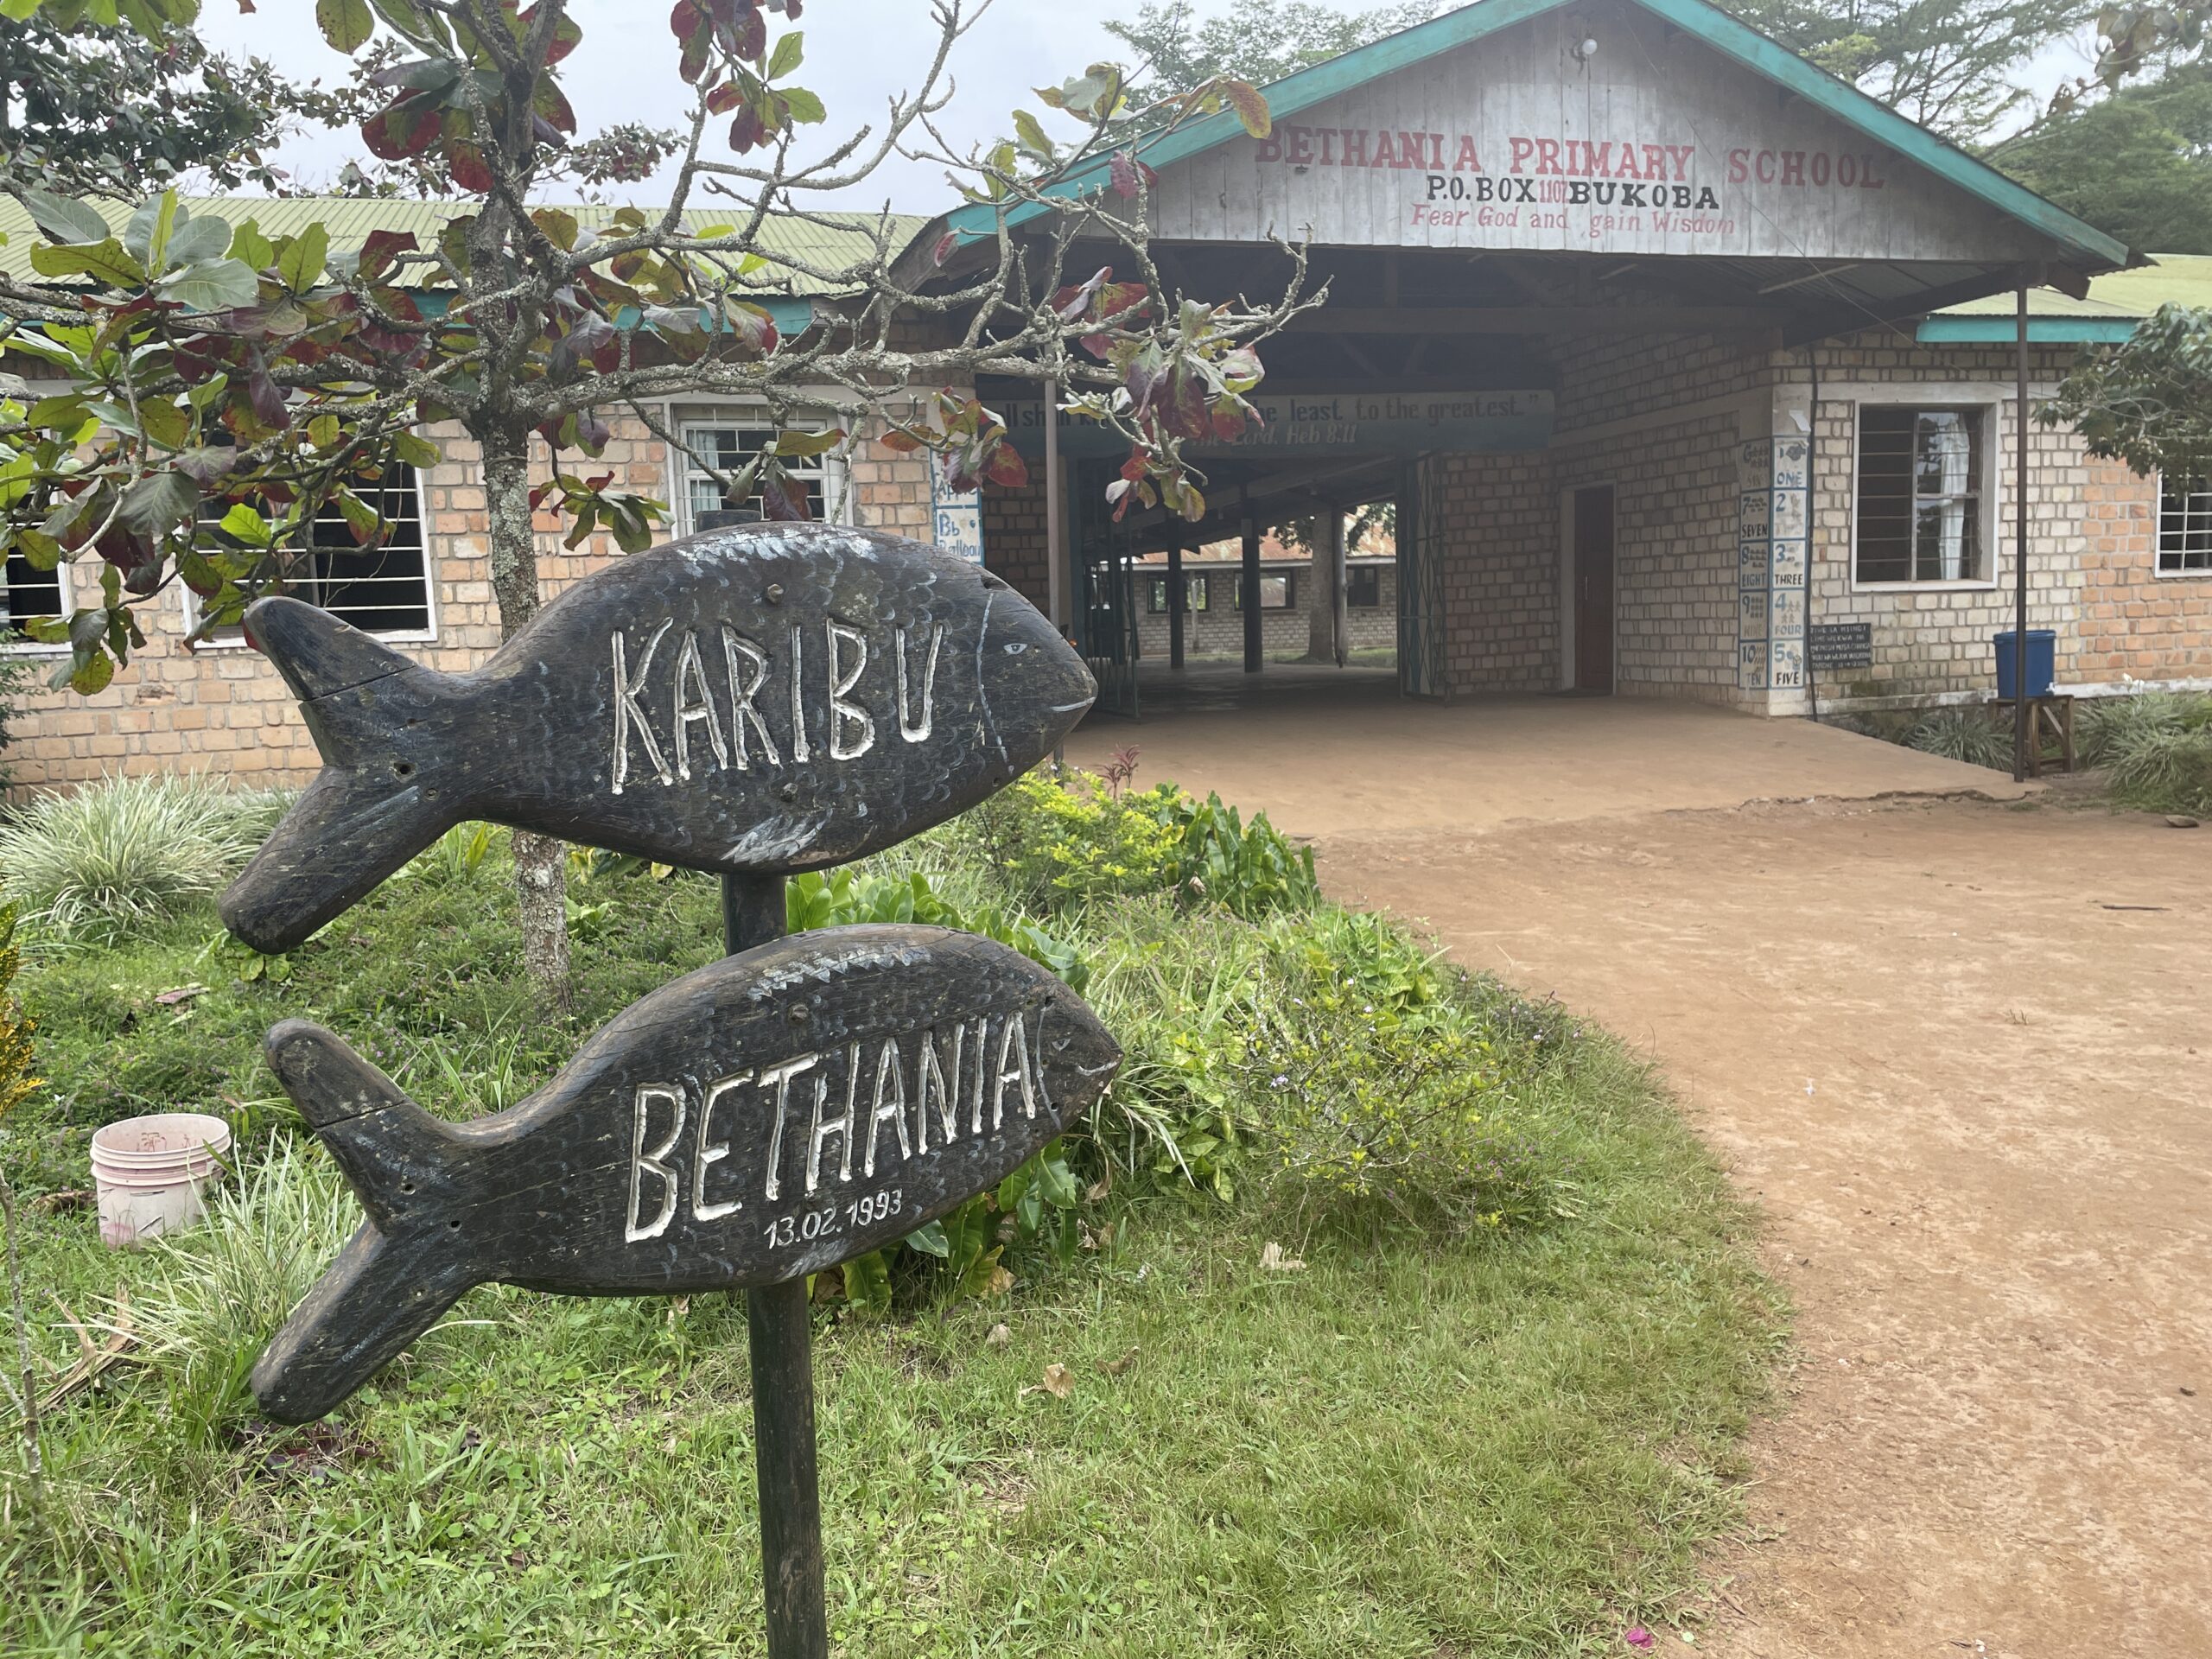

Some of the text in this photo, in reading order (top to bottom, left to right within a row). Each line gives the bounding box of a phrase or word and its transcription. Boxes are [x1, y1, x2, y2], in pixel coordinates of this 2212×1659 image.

[1255, 128, 1885, 189] BETHANIA PRIMARY SCHOOL
[1568, 181, 1719, 209] BUKOBA
[1410, 203, 1734, 238] Fear God and gain Wisdom
[1355, 398, 1380, 422] to
[1386, 397, 1420, 420] the
[1286, 423, 1321, 445] Heb
[1777, 472, 1803, 485] ONE
[1742, 496, 1751, 516] 7
[1776, 493, 1787, 512] 2
[938, 513, 960, 537] Bb
[1741, 524, 1768, 537] SEVEN
[1741, 545, 1751, 564] 8
[1775, 543, 1787, 563] 3
[1741, 573, 1767, 587] EIGHT
[1774, 574, 1803, 585] THREE
[1742, 595, 1751, 614] 9
[1775, 593, 1787, 610] 4
[1775, 624, 1802, 635] FOUR
[1742, 644, 1757, 664] 10
[1774, 643, 1786, 663] 5
[1776, 671, 1800, 685] FIVE
[611, 616, 944, 795] KARIBU
[624, 1009, 1036, 1243] BETHANIA
